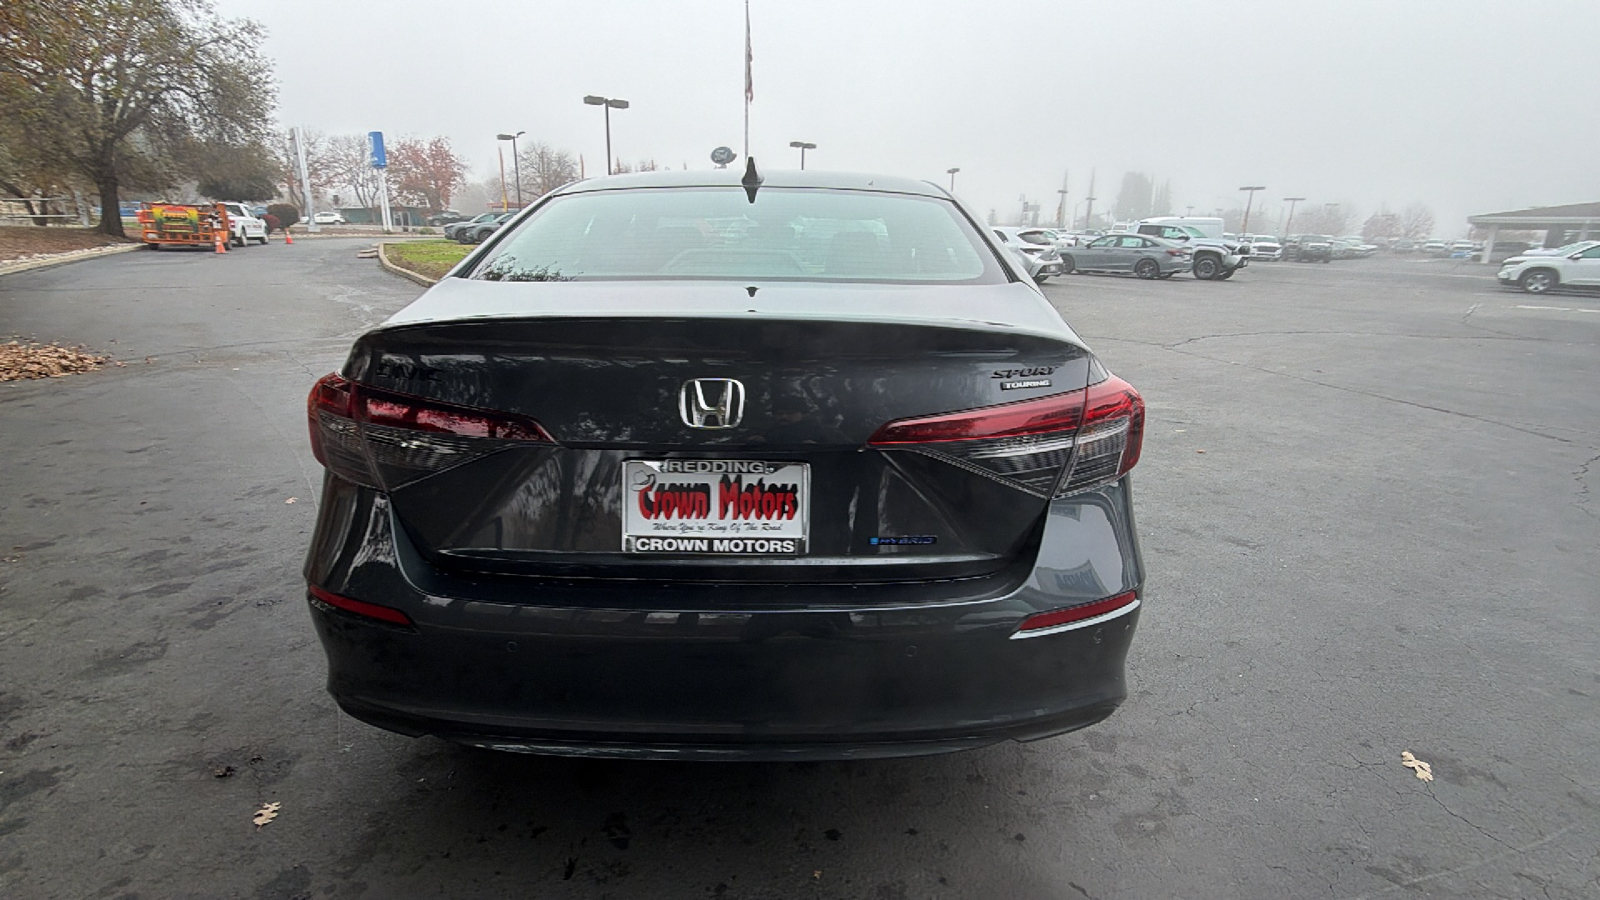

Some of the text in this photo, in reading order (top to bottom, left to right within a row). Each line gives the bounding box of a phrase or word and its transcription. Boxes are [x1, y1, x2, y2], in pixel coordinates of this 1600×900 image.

[990, 366, 1060, 379] SPORT
[1004, 380, 1050, 389] TOURING
[669, 461, 765, 473] REDDING
[638, 475, 798, 521] Crown Motors
[652, 522, 678, 531] Where
[707, 522, 728, 533] King
[729, 522, 742, 534] Of
[743, 522, 759, 531] The
[762, 522, 783, 531] Road
[636, 539, 795, 553] CROWN MOTORS
